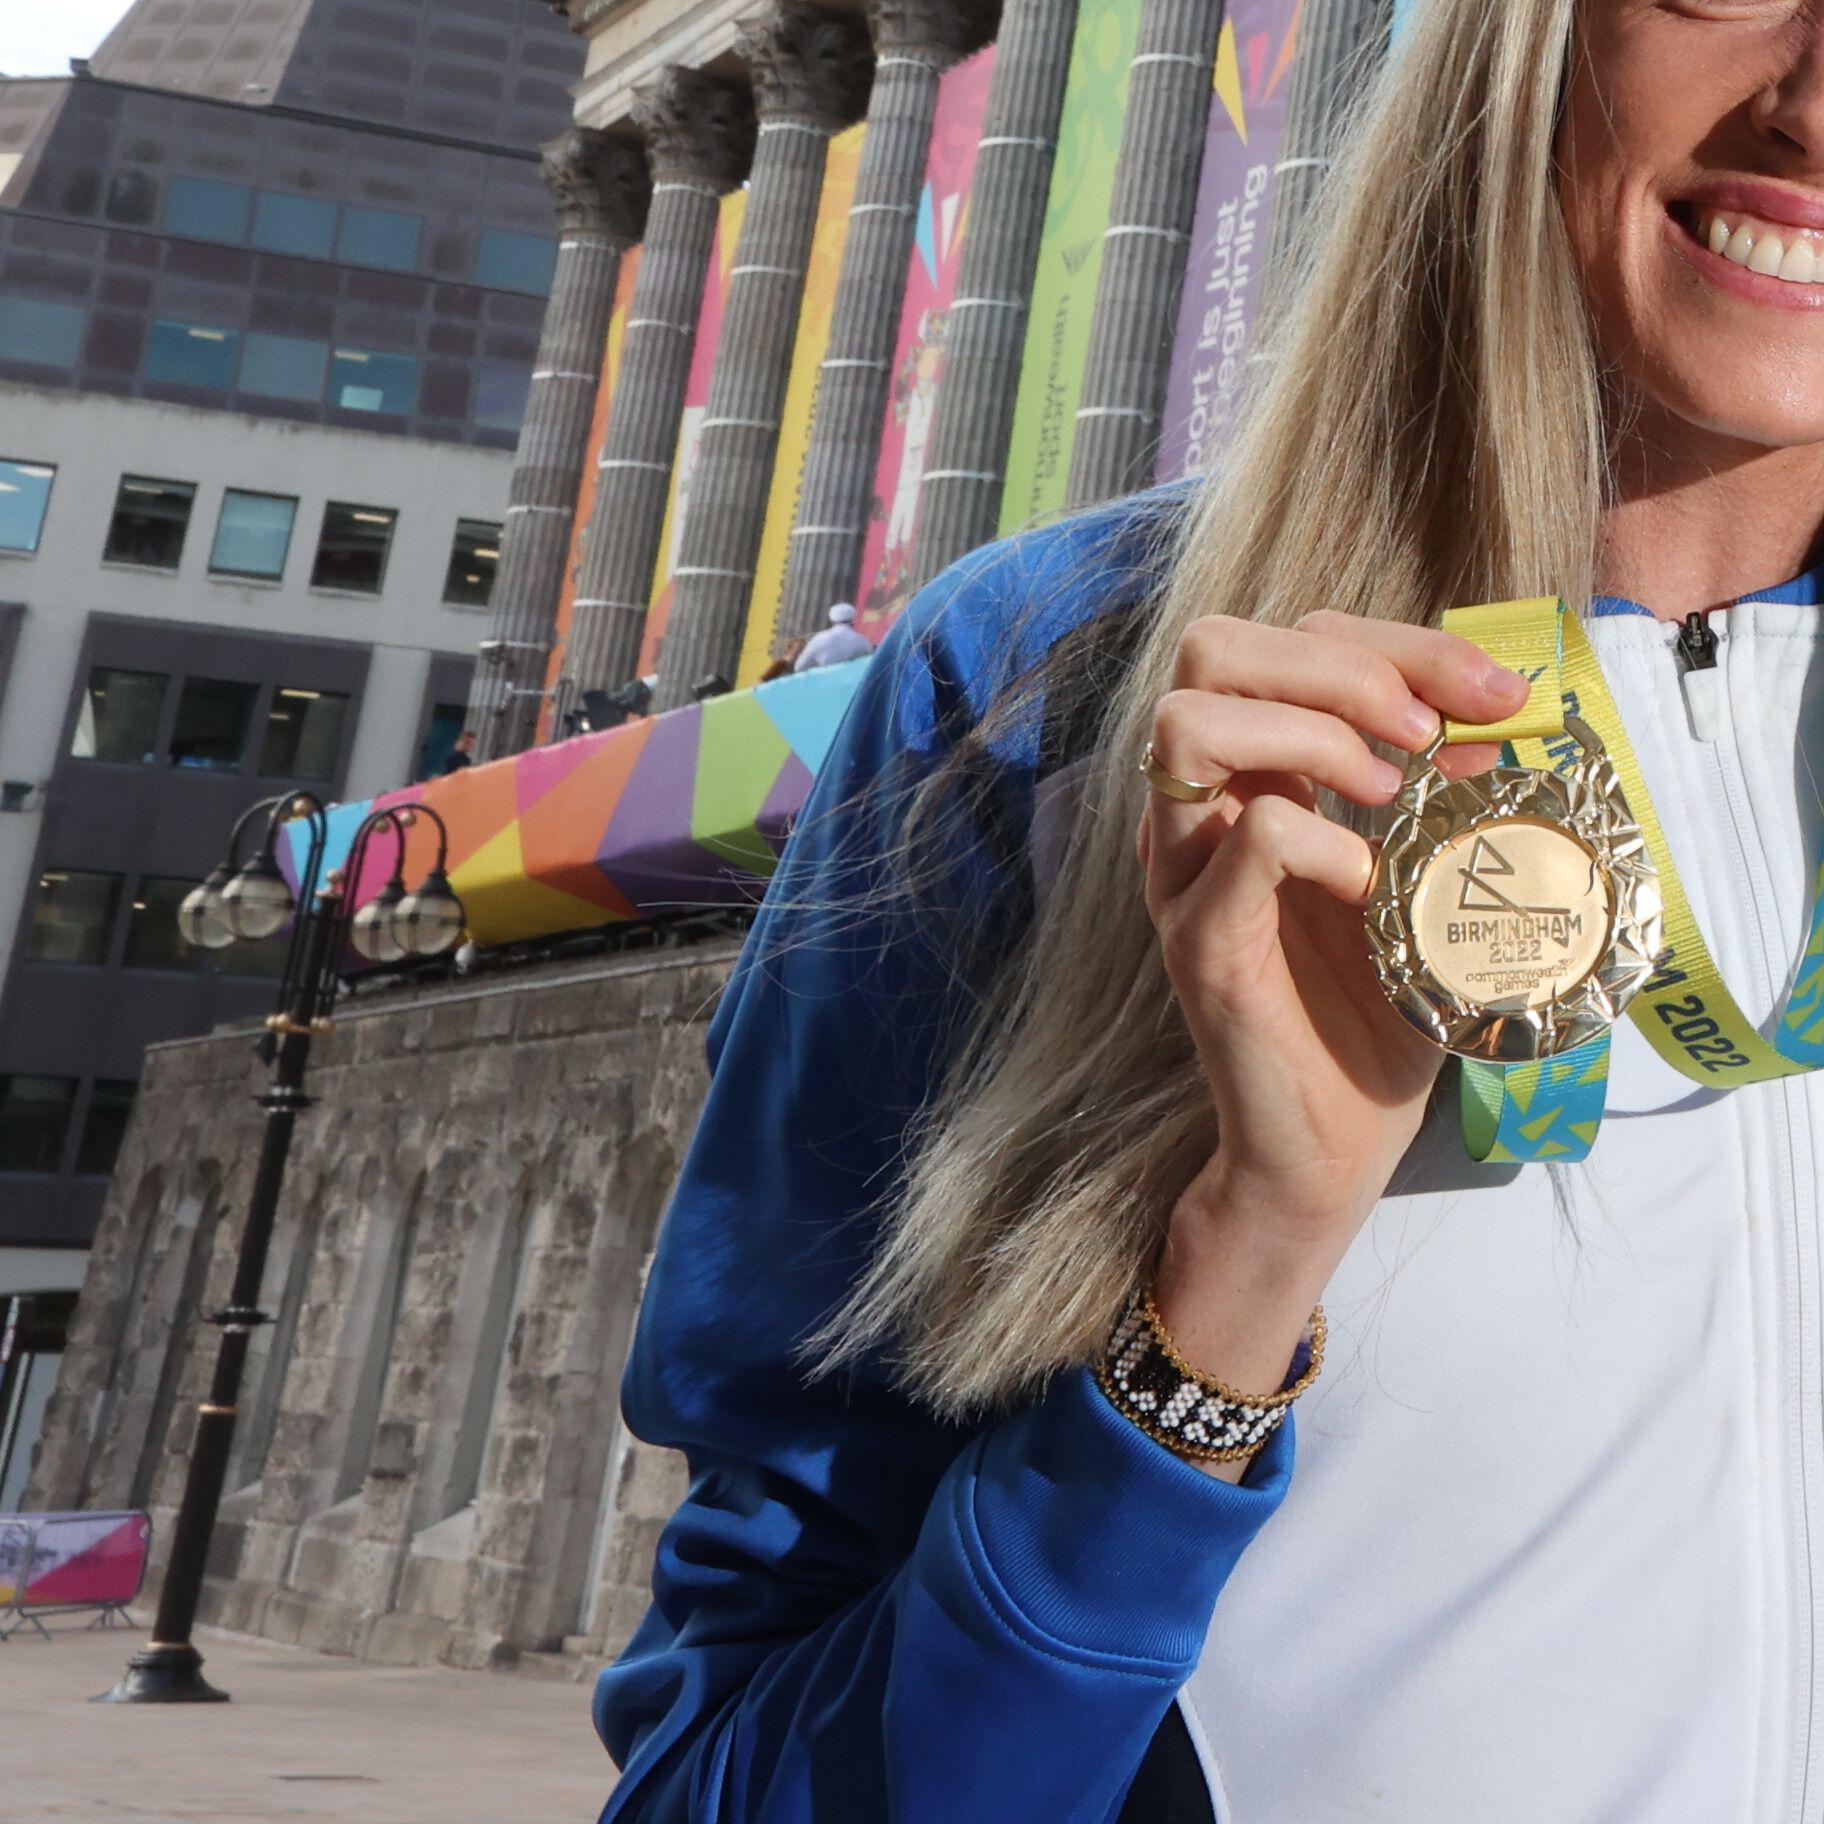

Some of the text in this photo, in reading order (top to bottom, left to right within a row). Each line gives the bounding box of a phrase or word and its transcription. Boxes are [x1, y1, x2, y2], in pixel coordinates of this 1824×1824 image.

[1183, 196, 1239, 477] port is just
[1447, 914, 1582, 945] BIRMINGHAM
[1489, 939, 1542, 964] 2022
[1654, 994, 1751, 1073] 2022
